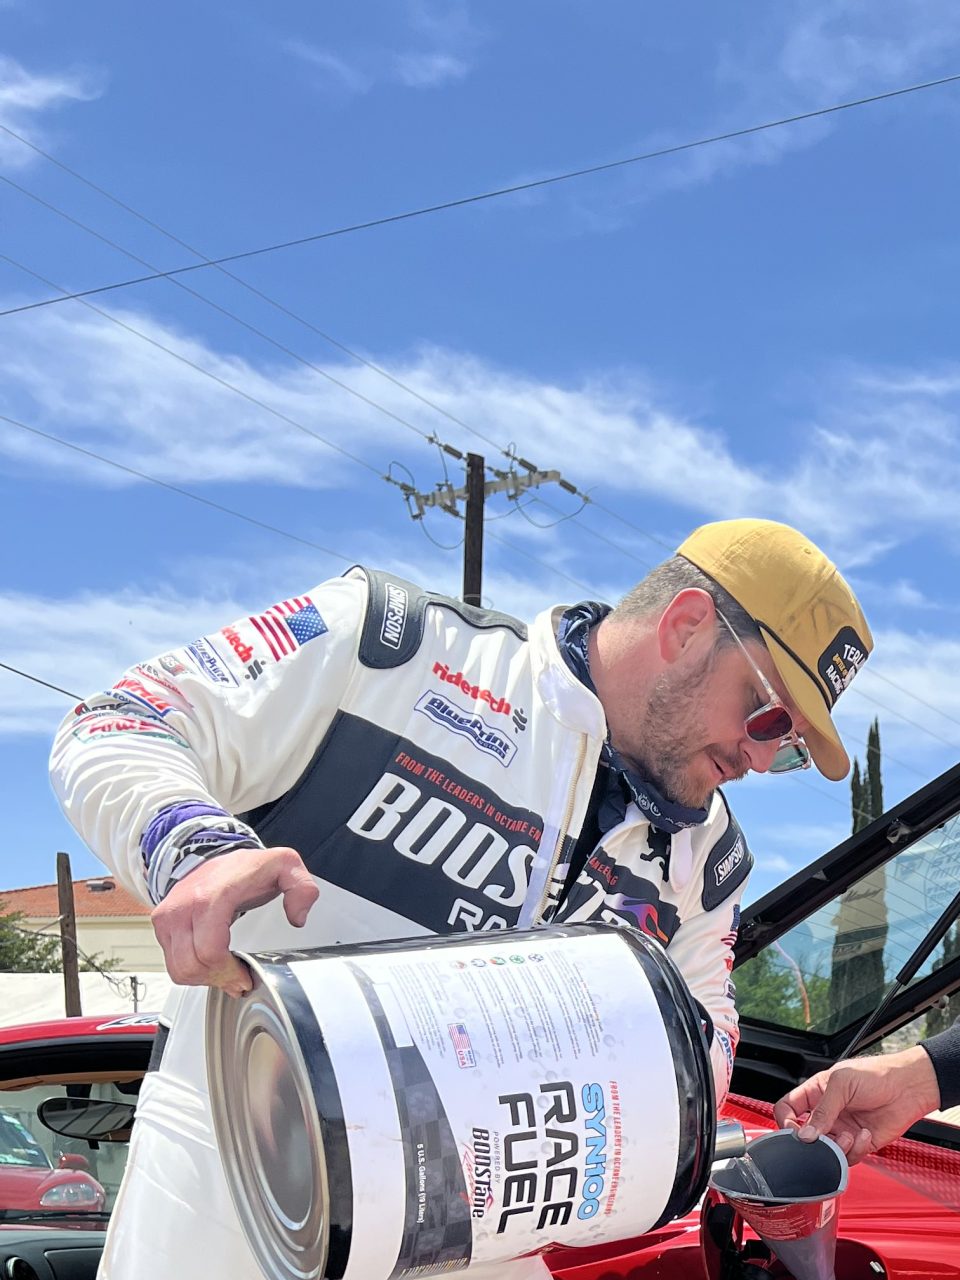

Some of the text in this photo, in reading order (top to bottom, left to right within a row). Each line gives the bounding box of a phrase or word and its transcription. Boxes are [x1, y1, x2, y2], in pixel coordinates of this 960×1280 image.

[383, 585, 407, 648] SIMPSON
[432, 661, 511, 716] ridetech
[428, 697, 510, 754] BluePrint
[395, 752, 425, 776] FROM
[424, 768, 445, 785] THE
[442, 778, 485, 810] LEADERS
[484, 803, 496, 817] IN
[494, 813, 530, 833] OCTANE
[609, 1080, 619, 1100] FROM
[493, 1131, 501, 1171] POWERED
[536, 1081, 579, 1230] RACE
[577, 1082, 607, 1220] SYN100
[613, 1116, 622, 1146] LEADERS
[418, 1166, 427, 1192] Gallons
[497, 1093, 538, 1234] FUEL
